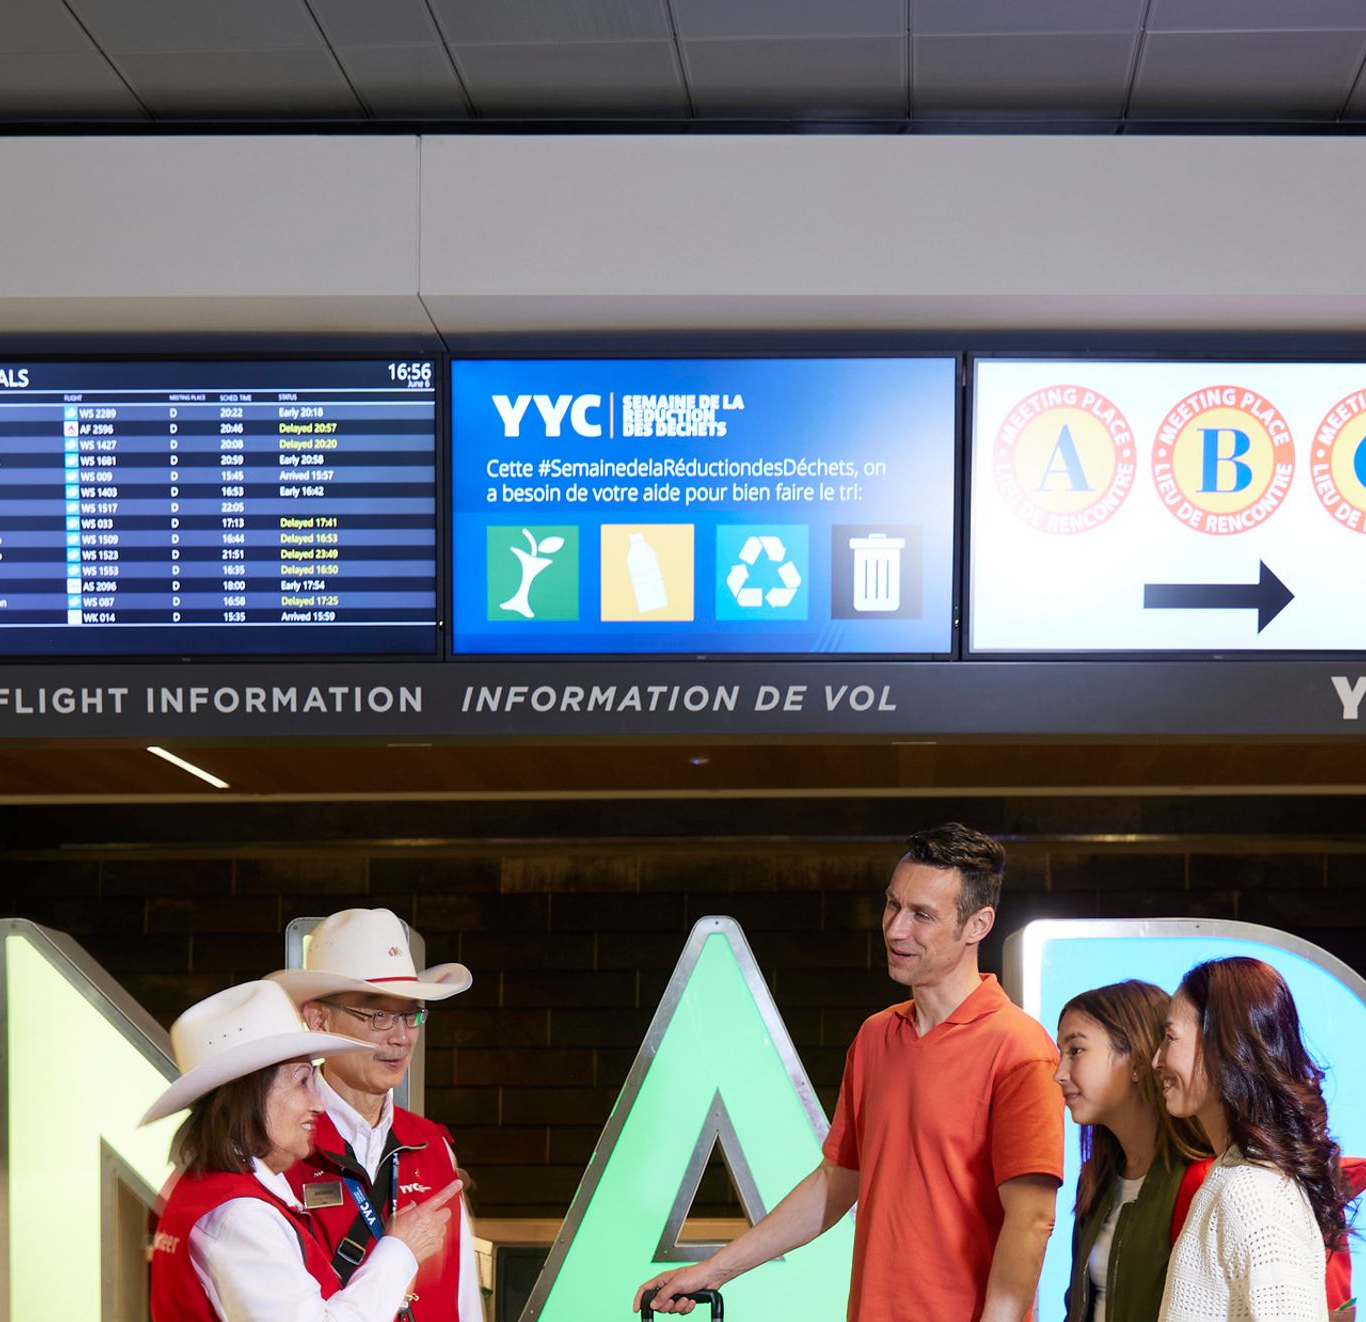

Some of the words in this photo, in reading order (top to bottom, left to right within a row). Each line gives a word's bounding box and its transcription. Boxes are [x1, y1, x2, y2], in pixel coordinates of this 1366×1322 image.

[388, 363, 431, 380] 16:56
[407, 380, 423, 388] June
[622, 394, 696, 410] SEMAINE
[699, 394, 720, 410] DE
[723, 394, 744, 410] LA
[279, 407, 299, 419] Early
[492, 394, 602, 438] YYC
[1001, 387, 1077, 444] MEETING
[1081, 391, 1131, 446] PLACE
[1158, 387, 1236, 446] MEETING
[1240, 391, 1291, 447] PLACE
[279, 423, 312, 435] Delayed
[622, 421, 653, 437] DES
[280, 439, 313, 451] Delayed
[280, 455, 299, 466] Early
[1033, 423, 1097, 492] A
[1195, 428, 1253, 493] B
[280, 471, 309, 480] Arrived
[487, 459, 533, 477] Cette
[538, 457, 858, 478] #SemainedelaRéductiondesDéchets,
[864, 461, 886, 476] on
[280, 486, 300, 498] Early
[486, 487, 497, 502] a
[502, 483, 561, 502] besoin
[565, 483, 588, 502] de
[592, 484, 638, 502] votre
[643, 483, 681, 502] aide
[685, 486, 728, 506] pour
[733, 483, 770, 501] bien
[775, 482, 814, 501] faire
[820, 482, 834, 500] le
[839, 483, 863, 501] tri:
[1047, 463, 1134, 532] RENCONTRE
[1155, 463, 1182, 506] LIEU
[1177, 502, 1203, 528] DE
[1205, 463, 1293, 533] RENCONTRE
[1313, 463, 1341, 506] LIEU
[1335, 502, 1362, 529] DE
[281, 518, 313, 529] Delayed
[281, 533, 313, 545] Delayed
[281, 549, 314, 561] Delayed
[281, 565, 314, 576] Delayed
[281, 581, 301, 592] Early
[282, 596, 314, 608] Delayed
[281, 612, 311, 621] Arrived
[146, 686, 422, 713] INFORMATION
[461, 685, 740, 712] INFORMATION
[754, 685, 807, 711] DE
[824, 685, 898, 711] VOL
[360, 1201, 377, 1226] YYC
